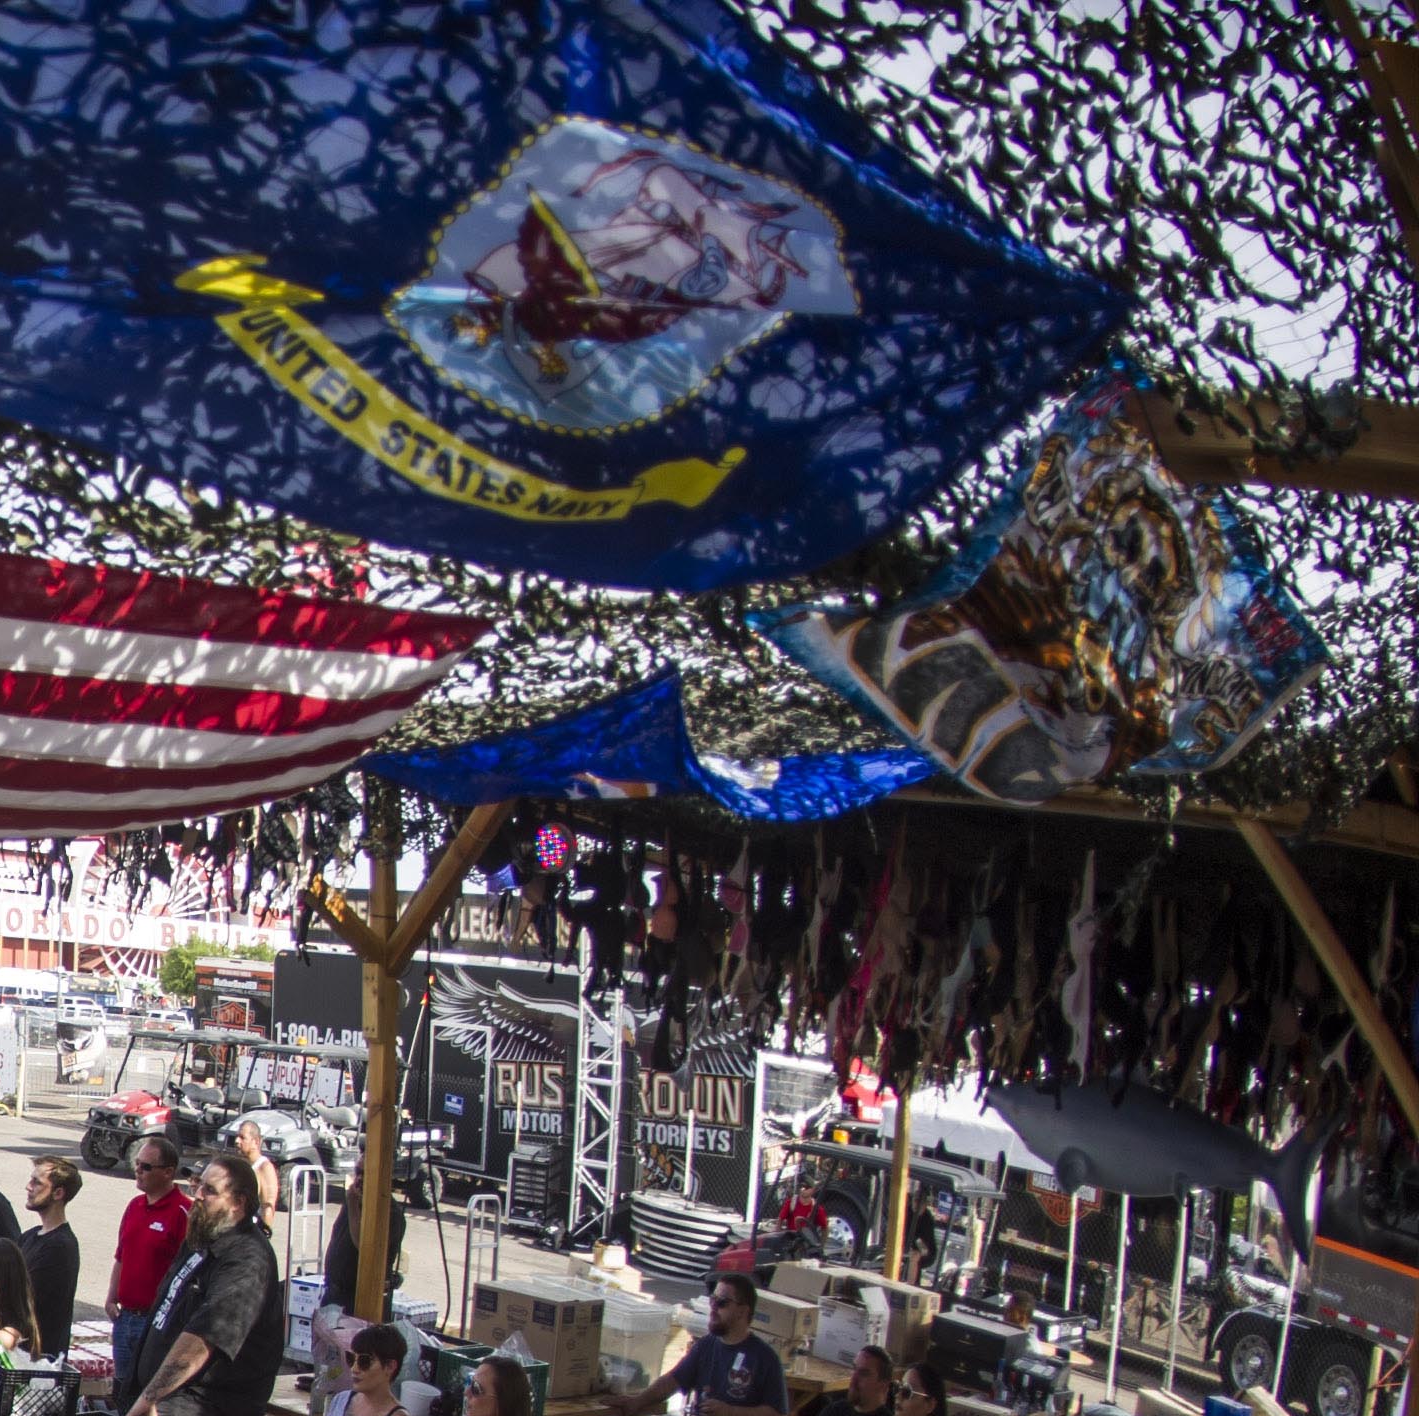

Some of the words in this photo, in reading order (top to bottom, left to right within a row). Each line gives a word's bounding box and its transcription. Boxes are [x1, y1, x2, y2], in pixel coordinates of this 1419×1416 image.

[240, 308, 369, 422] UNITED
[379, 419, 527, 505] STATES
[525, 492, 624, 518] NAVY
[494, 1063, 563, 1105] RUS
[638, 1069, 744, 1126] ROWN
[637, 1120, 732, 1152] TTORNEYS
